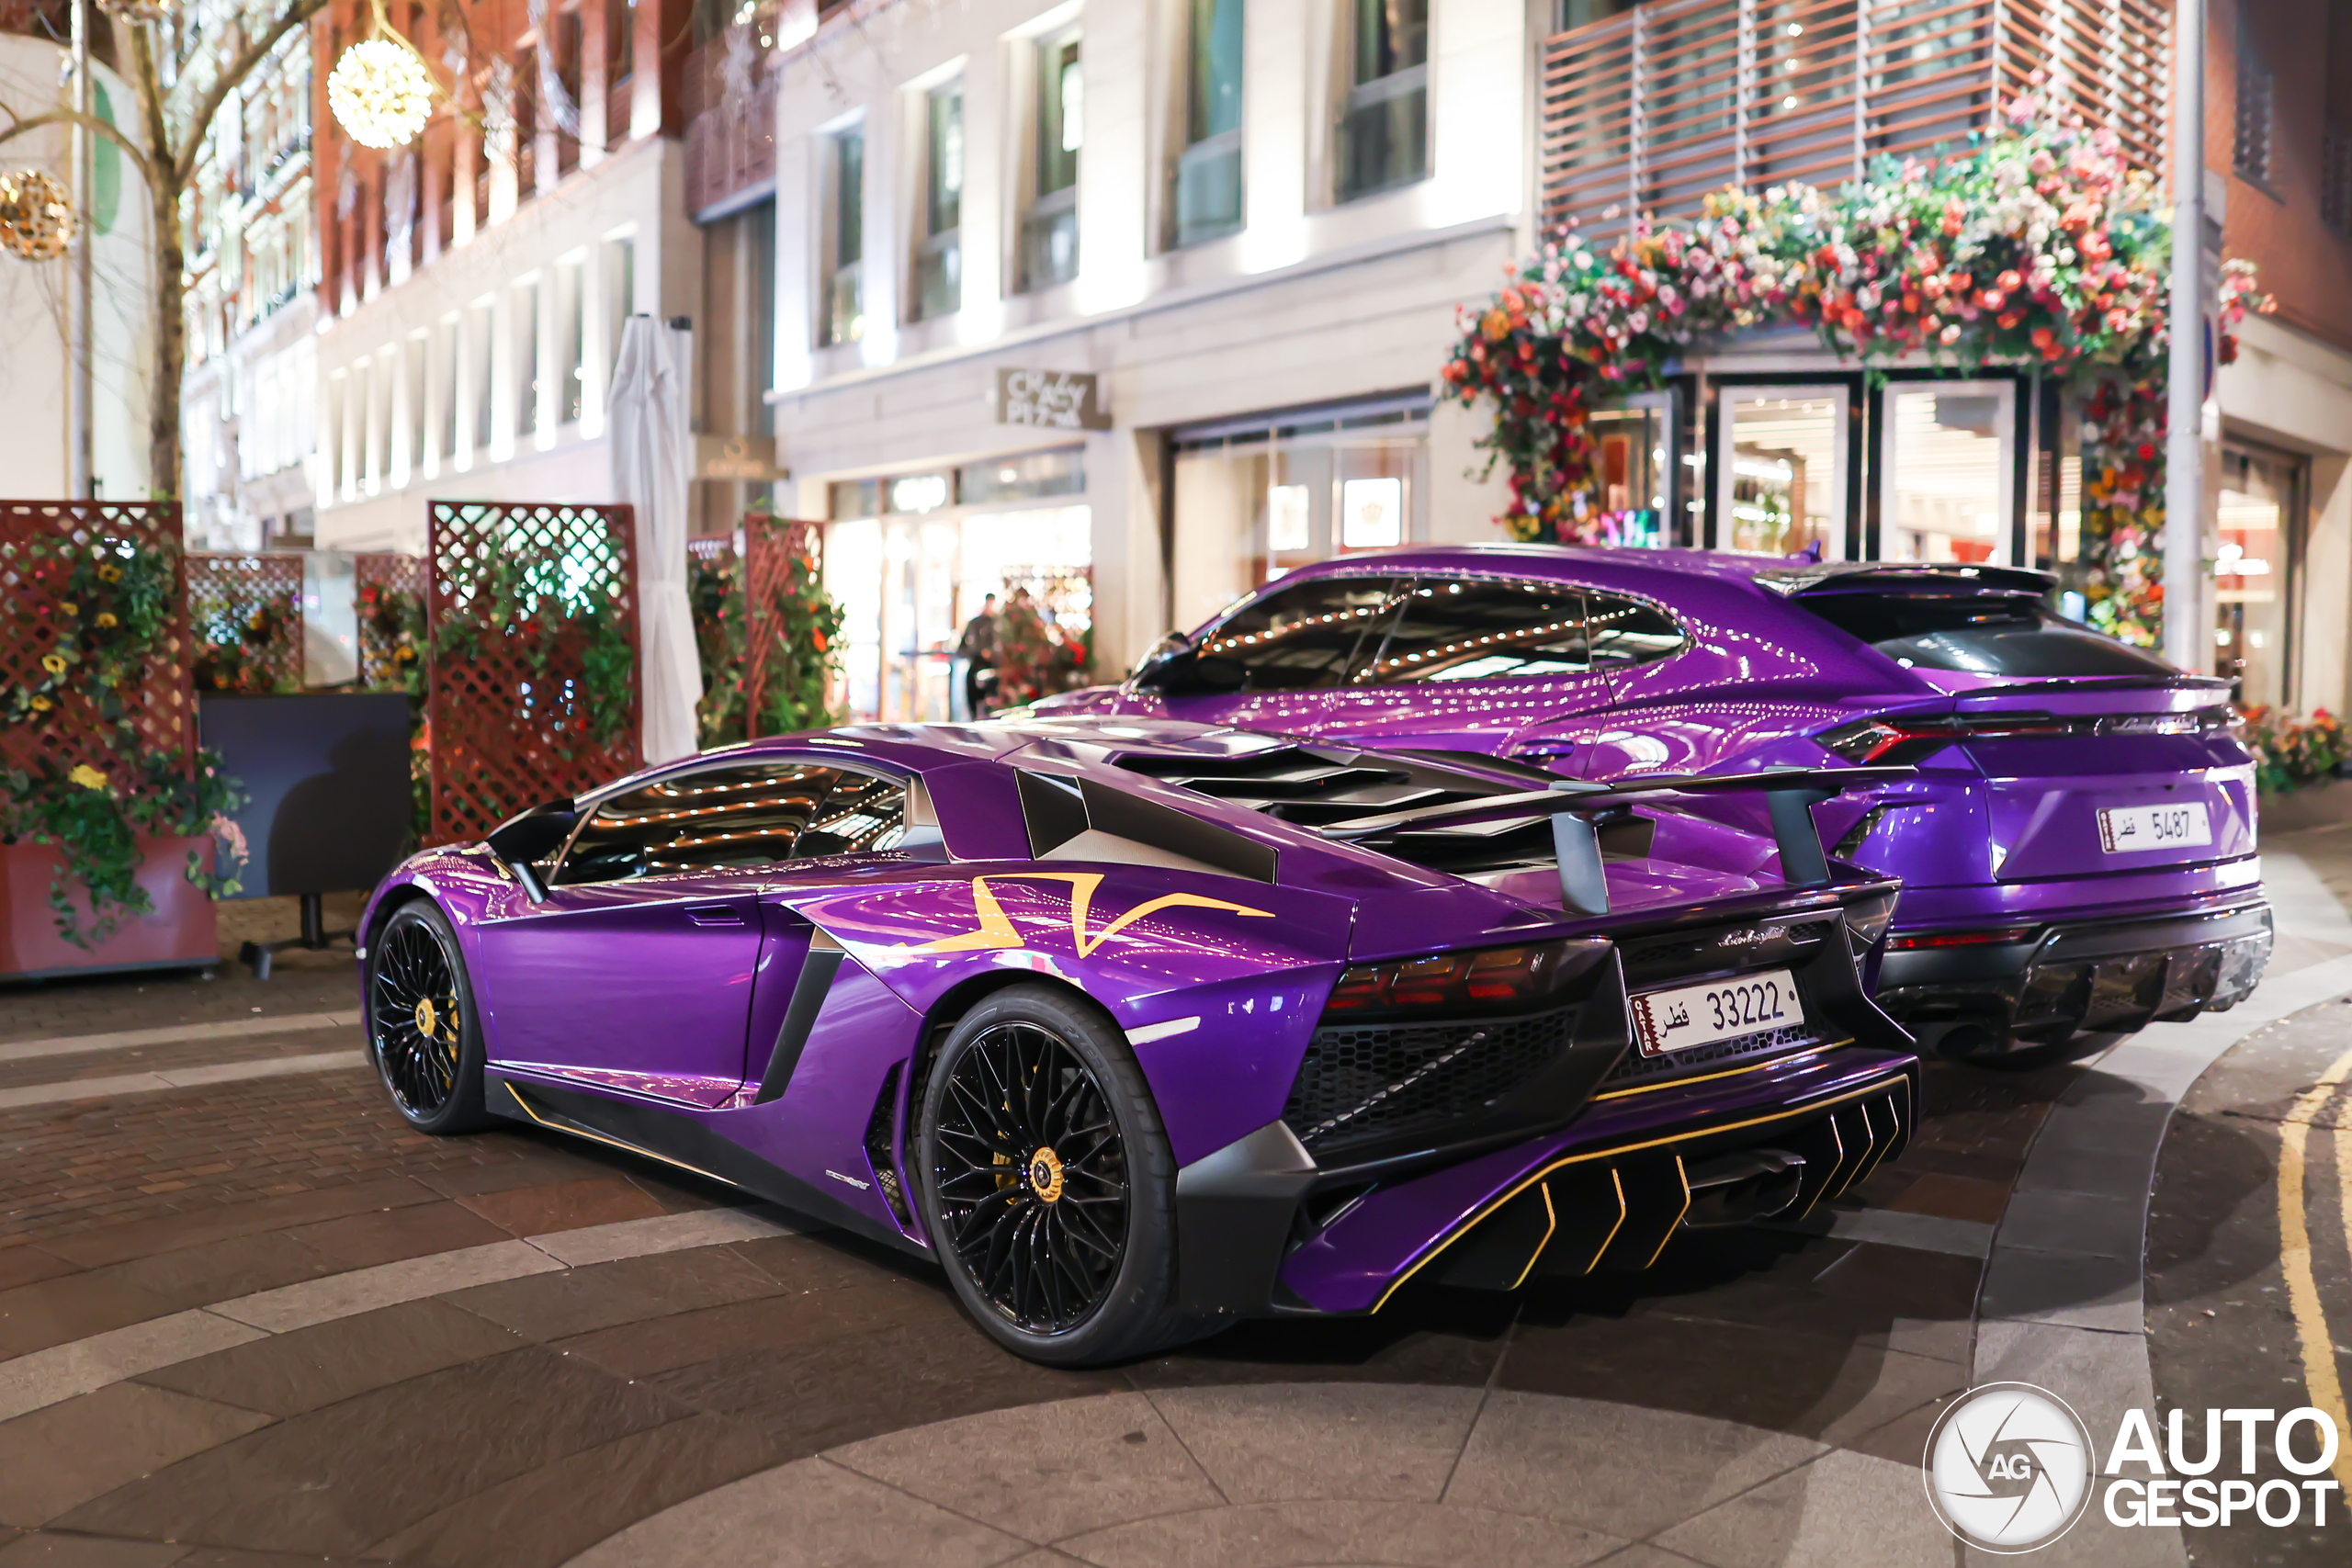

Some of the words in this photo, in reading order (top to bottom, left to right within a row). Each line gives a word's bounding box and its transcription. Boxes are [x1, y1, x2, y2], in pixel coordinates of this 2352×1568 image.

[2152, 811, 2189, 840] 5487
[1634, 999, 1653, 1052] QATAR
[1658, 1000, 1690, 1038] قطر
[1706, 980, 1784, 1031] 33222
